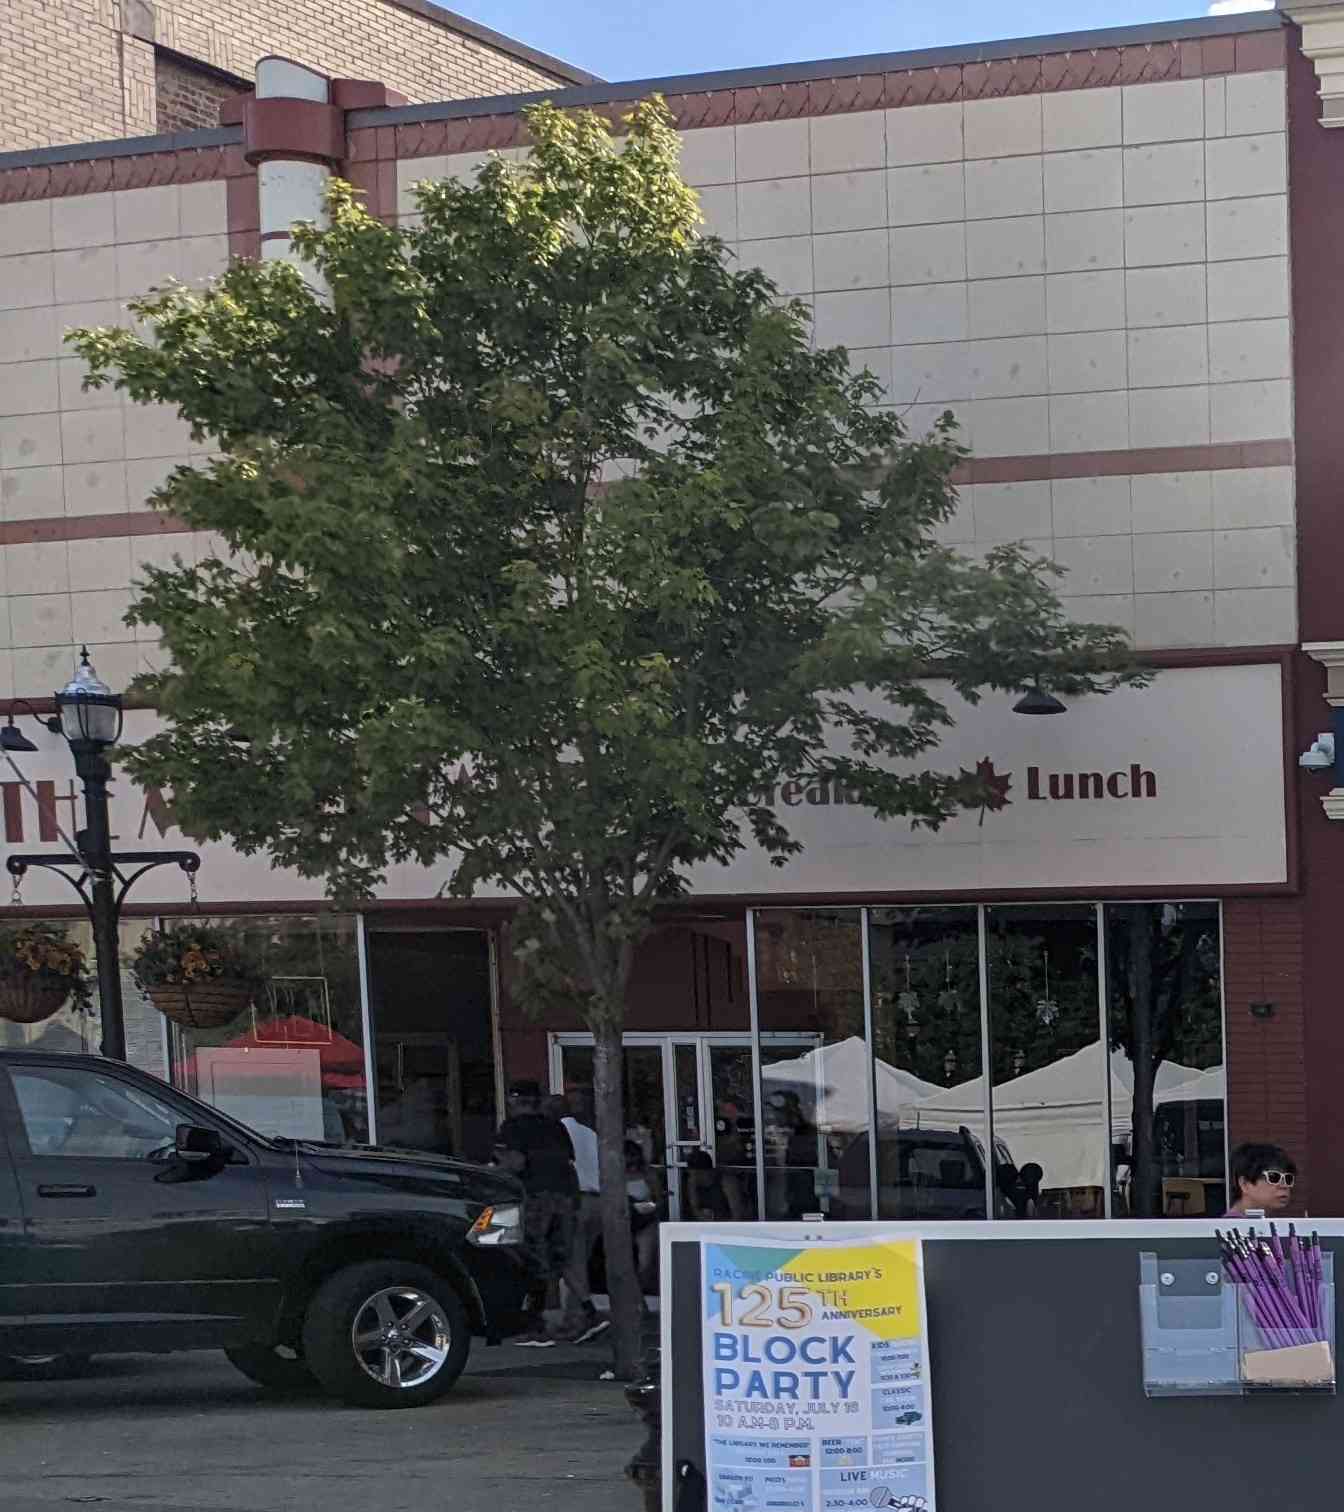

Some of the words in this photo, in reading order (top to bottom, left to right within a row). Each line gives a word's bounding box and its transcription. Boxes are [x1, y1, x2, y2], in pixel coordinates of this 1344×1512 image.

[1026, 763, 1158, 801] Lunch
[767, 1271, 814, 1283] PUBLIC
[821, 1306, 903, 1321] ANNIVERSARY
[713, 1332, 856, 1365] BLOCK
[713, 1368, 856, 1401] PARTY
[803, 1401, 840, 1415] JULY
[840, 1471, 867, 1482] LIVE
